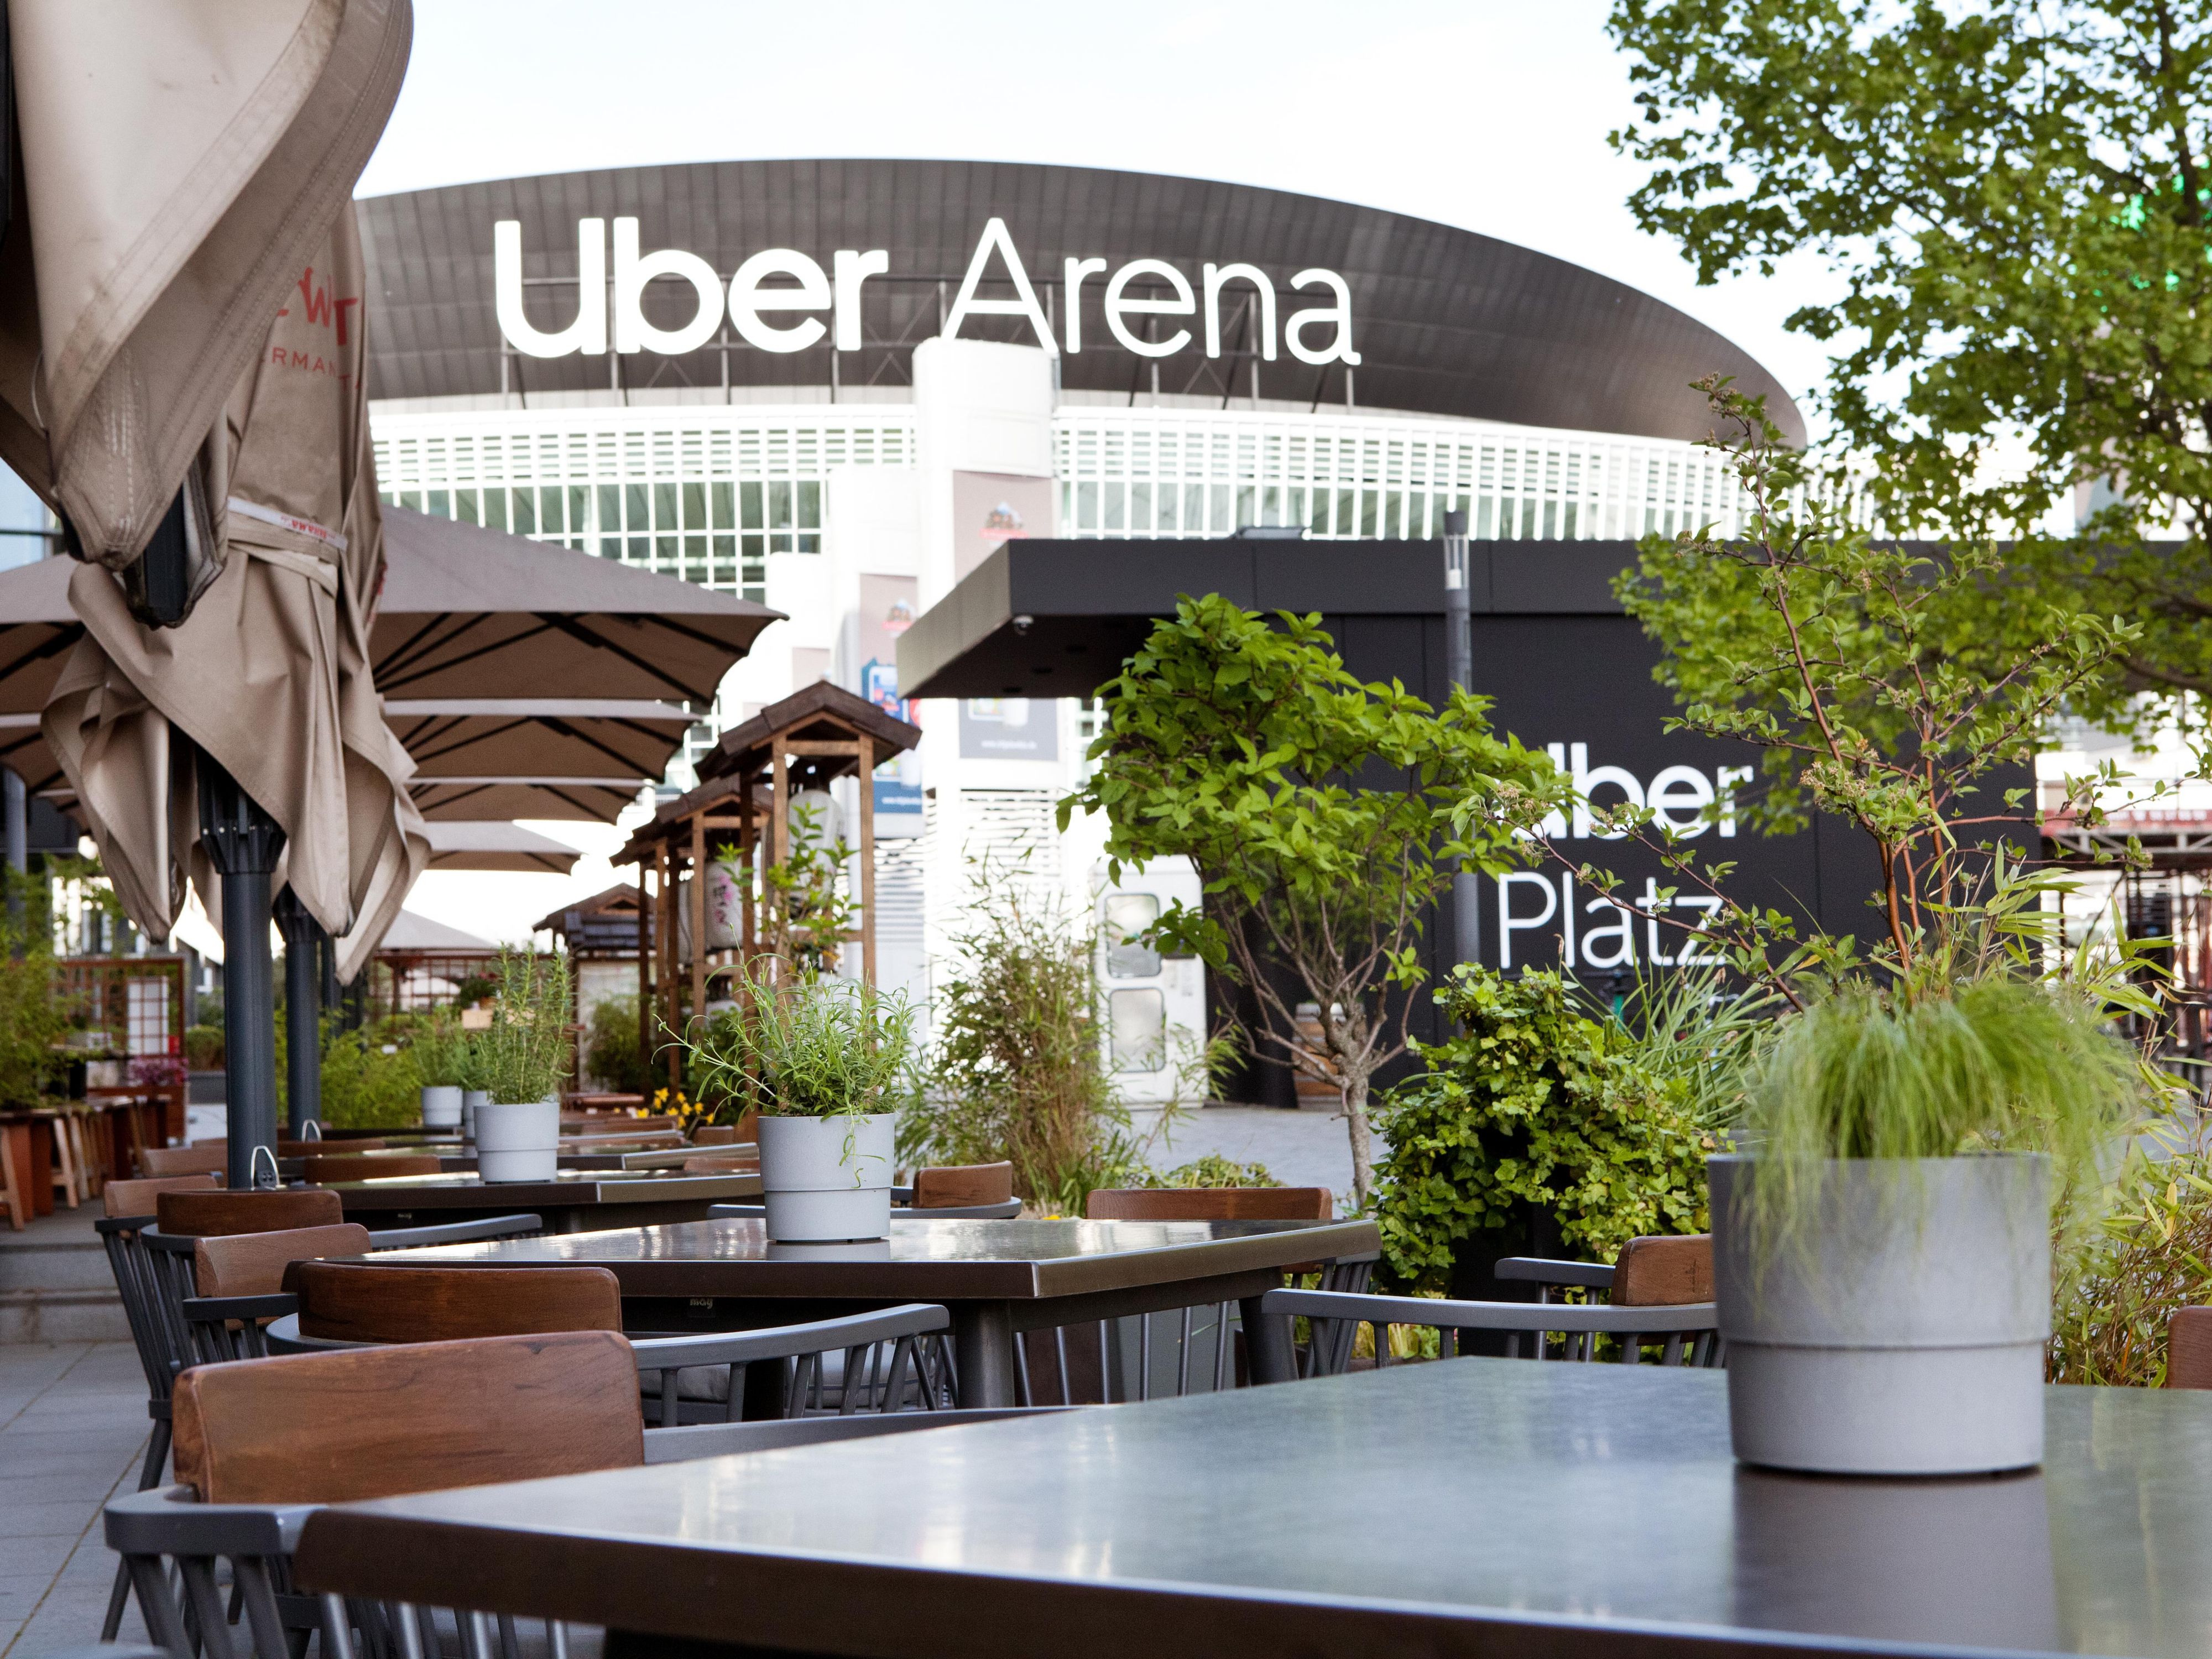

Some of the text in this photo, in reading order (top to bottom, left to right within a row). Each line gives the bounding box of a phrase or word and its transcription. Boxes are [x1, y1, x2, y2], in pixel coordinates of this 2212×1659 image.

[494, 216, 1361, 366] Uber Arena
[1499, 871, 1726, 969] Platz
